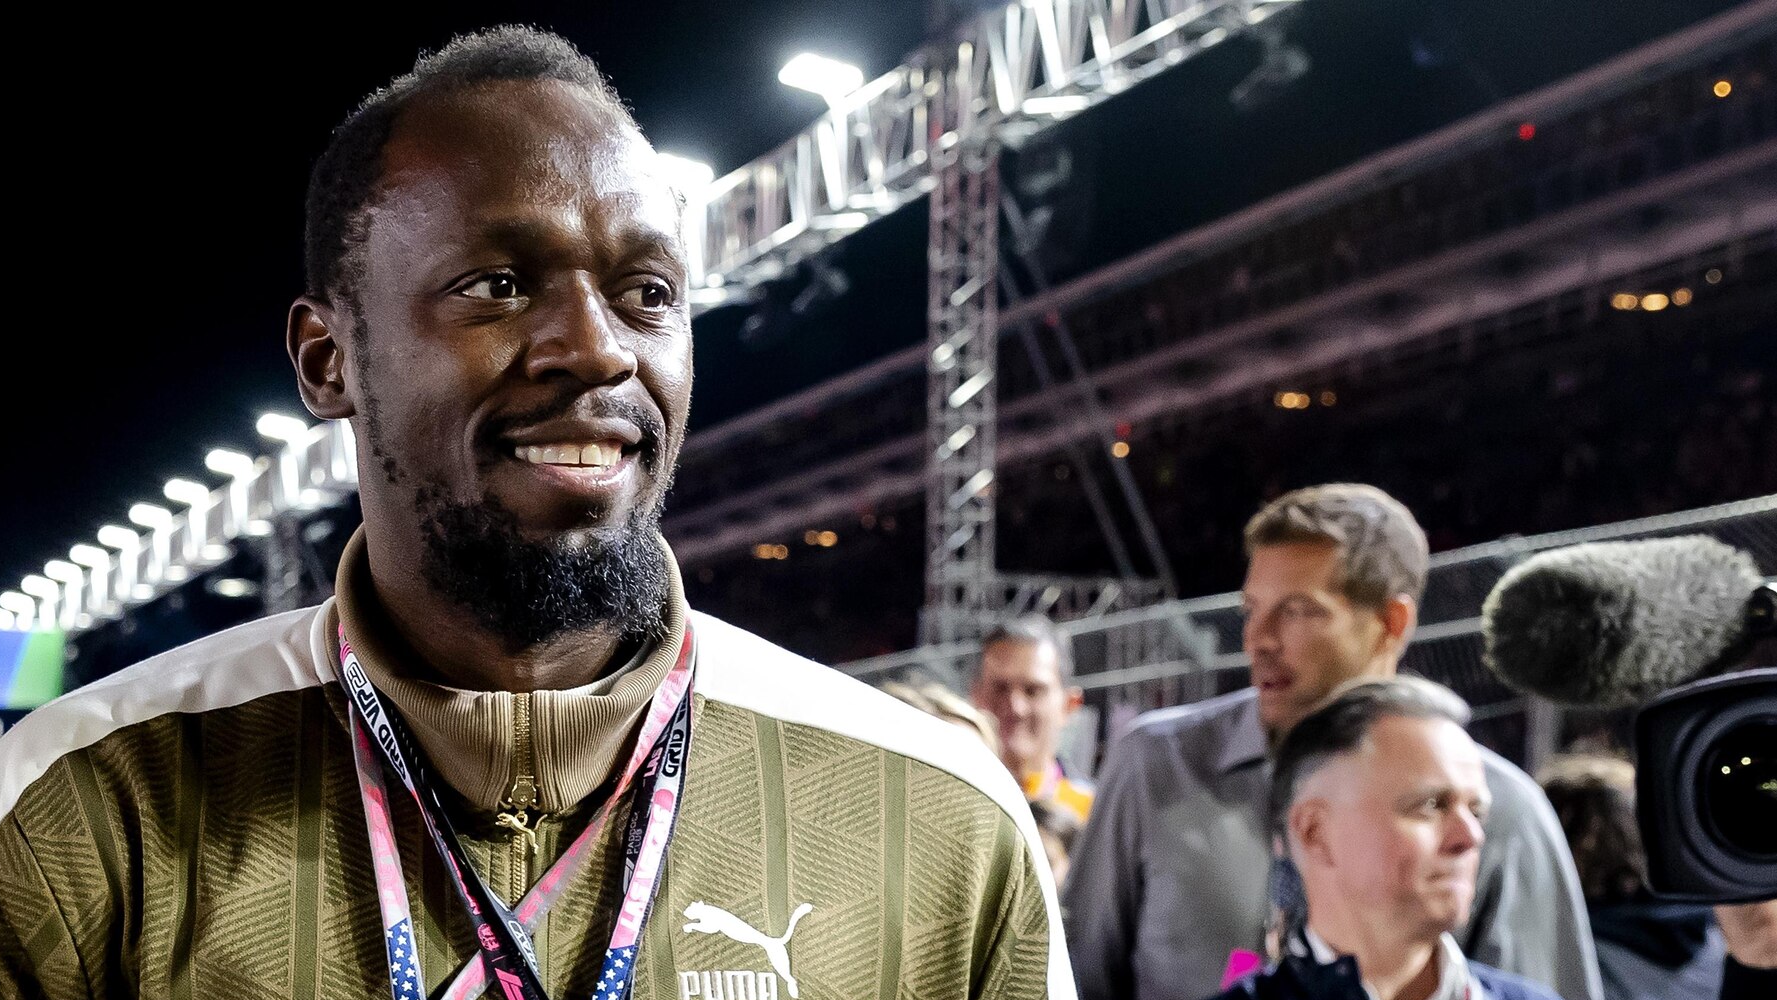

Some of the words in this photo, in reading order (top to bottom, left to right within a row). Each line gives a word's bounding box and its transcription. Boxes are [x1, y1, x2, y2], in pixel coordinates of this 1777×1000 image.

[355, 689, 379, 727] VIP
[643, 747, 662, 777] LAS
[662, 729, 683, 777] GRID
